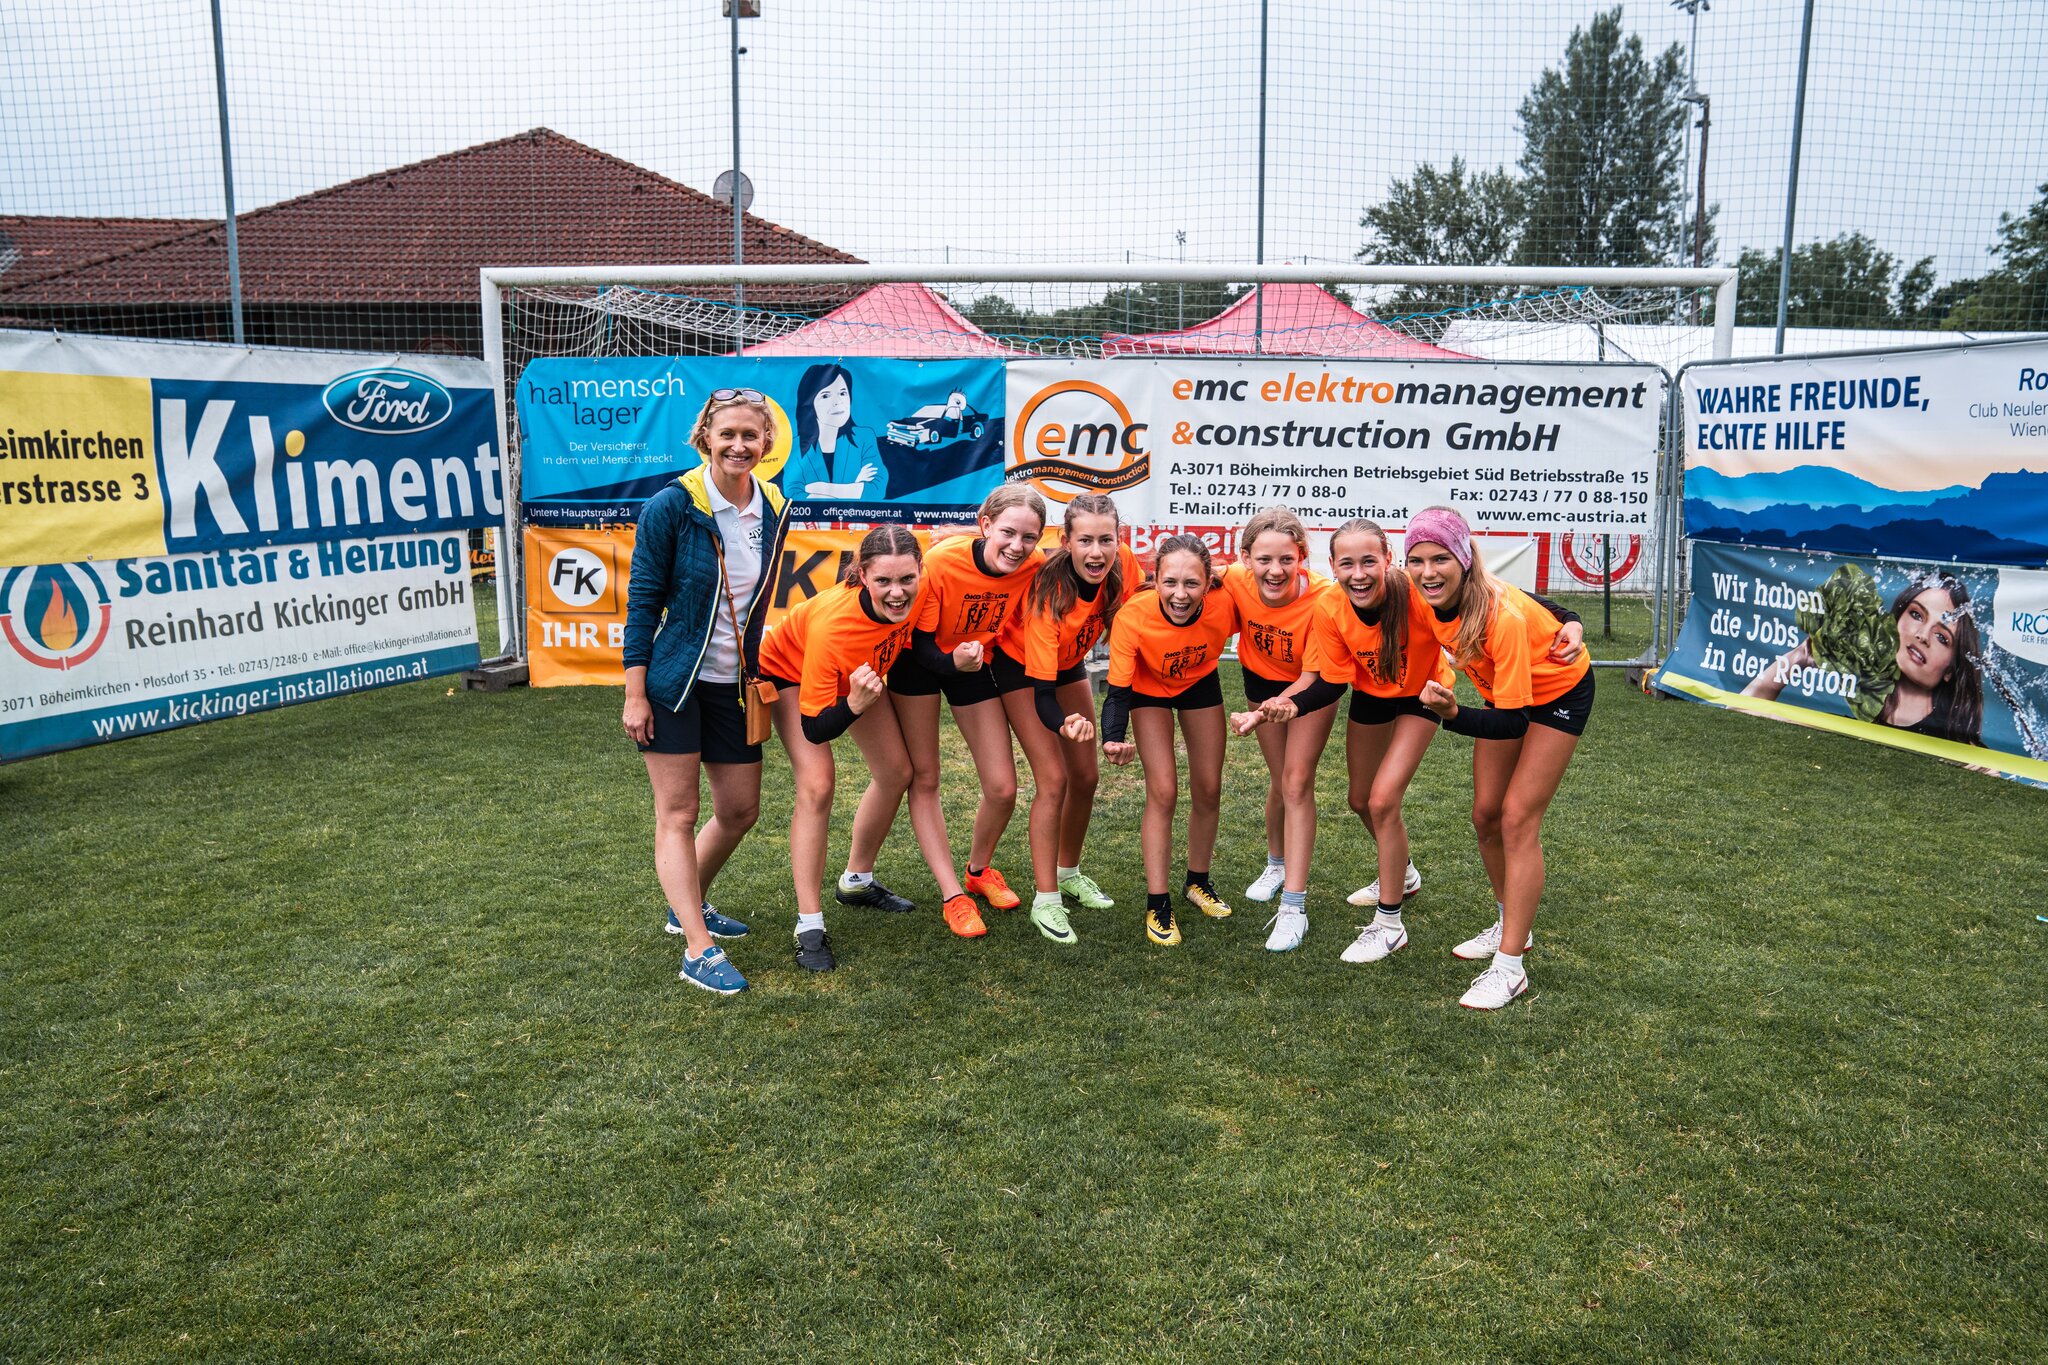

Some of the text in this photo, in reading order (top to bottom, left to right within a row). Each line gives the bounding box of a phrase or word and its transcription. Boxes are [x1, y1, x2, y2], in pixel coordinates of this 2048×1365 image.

[347, 377, 430, 424] Ford
[1172, 372, 1648, 414] emc elektromanagement
[1696, 376, 1930, 415] WAHRE FREUNDE,
[573, 402, 643, 431] lager
[1969, 402, 1999, 419] Club
[0, 428, 144, 460] eimkirchen
[569, 441, 649, 453] Der Versicherer,
[1036, 423, 1149, 457] emc
[1172, 419, 1561, 452] &construction GmbH
[1697, 421, 1846, 450] ECHTE HILFE
[160, 398, 503, 538] Kliment
[543, 456, 553, 465] in
[556, 456, 579, 465] dem
[582, 456, 599, 465] viel
[602, 455, 642, 465] Mensch
[1170, 462, 1649, 484] A-3071 Böheimkirchen Betriebsgebiet Süd Betriebsstraße 15
[0, 473, 150, 506] rstrasse 3
[1170, 483, 1347, 498] Tel.: 02743 / 77 0 88-0
[1450, 488, 1648, 505] Fax: 02743 / 77 0 88-150
[530, 508, 631, 519] Untere Hauptstraße 21
[822, 507, 902, 519] office@nvagent.at
[1477, 509, 1648, 524] www.emc-austria.at
[116, 536, 461, 598] Sanitär & Heizung
[1712, 572, 1825, 615] Wir haben
[125, 580, 465, 650] Reinhard Kickinger GmbH
[1710, 608, 1800, 648] die Jobs
[541, 622, 601, 648] IHR
[2022, 634, 2035, 644] DER
[2, 626, 472, 713] 3071 Böheimkirchen Plosdorf 35 Tel: 02743/2248-0 e-Mail: office@kickinger-installationen.at
[1700, 642, 1857, 698] in der Region
[92, 657, 428, 737] www.kickinger-installationen.at
